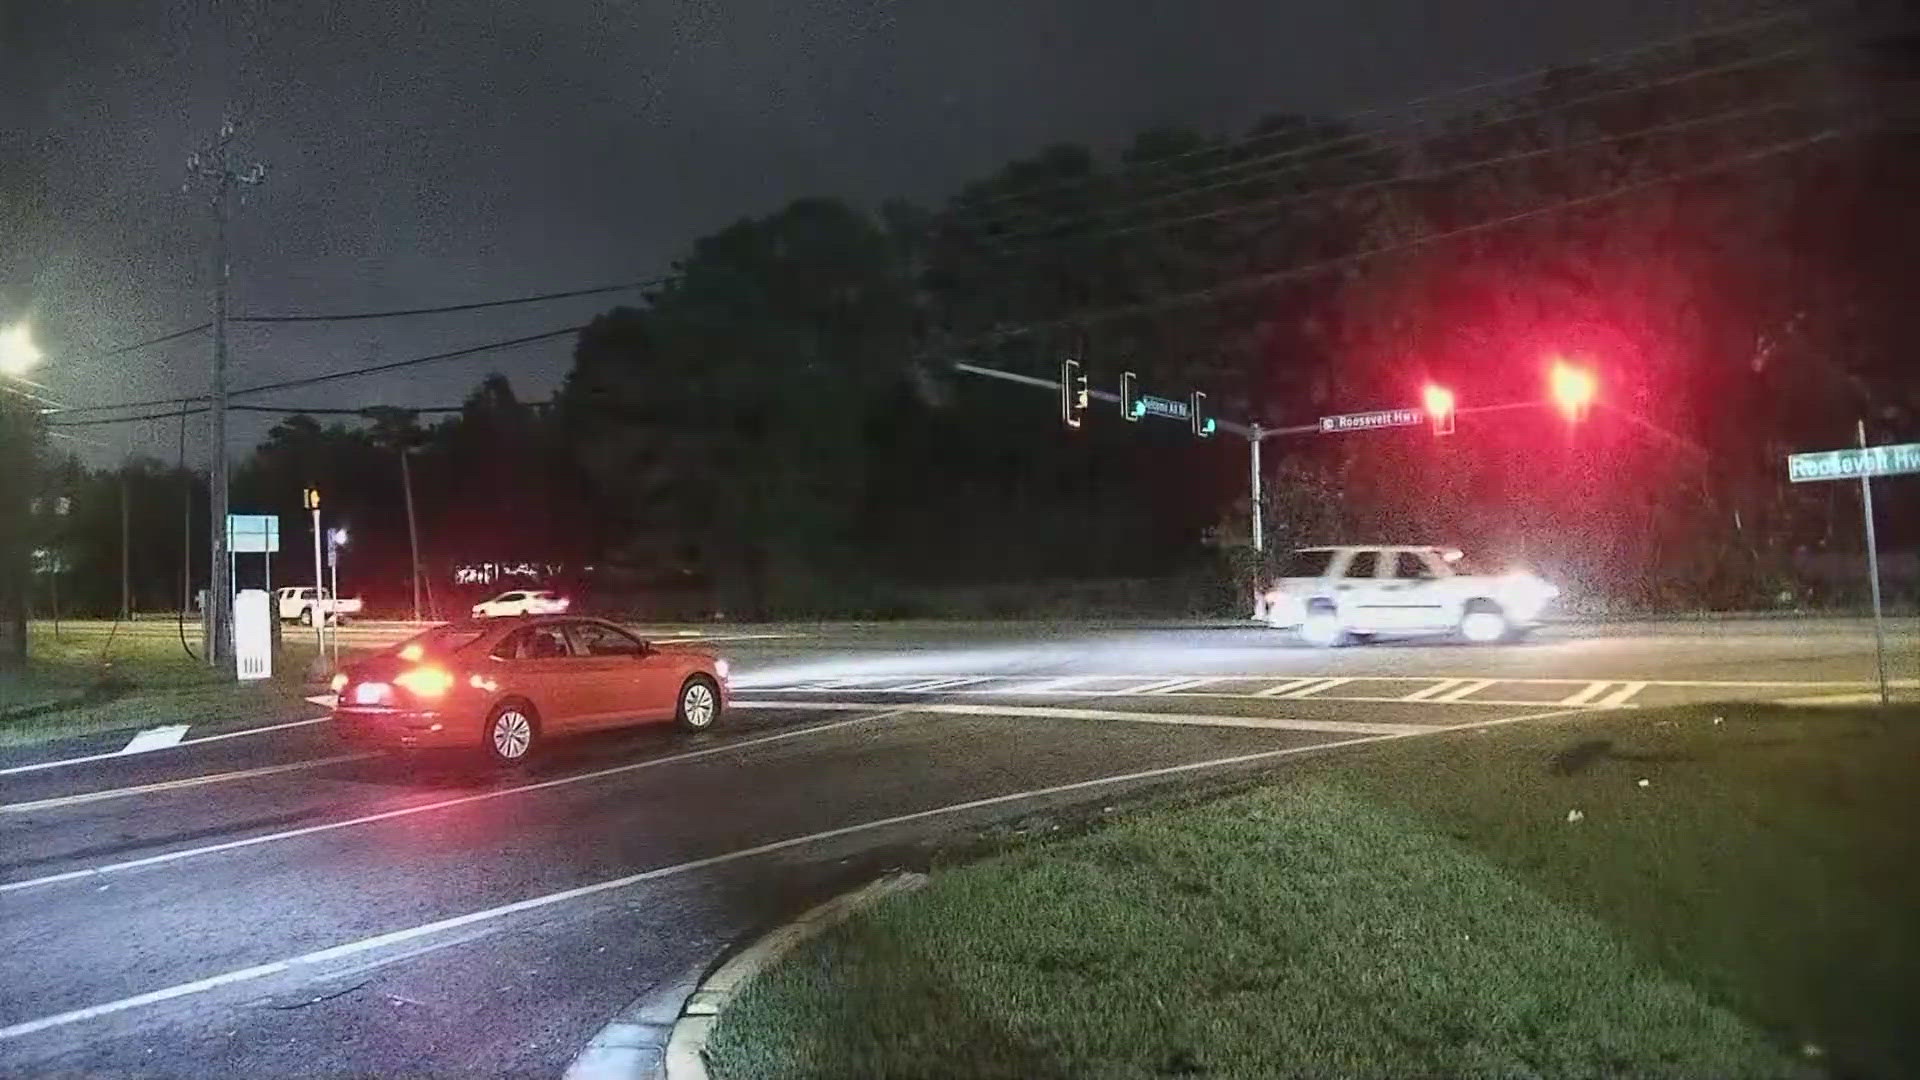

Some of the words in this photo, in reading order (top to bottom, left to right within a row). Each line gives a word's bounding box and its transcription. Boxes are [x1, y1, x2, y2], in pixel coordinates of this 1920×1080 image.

[1339, 413, 1392, 428] Roosevelt
[1393, 410, 1418, 424] Hwy
[1894, 446, 1920, 470] Hw
